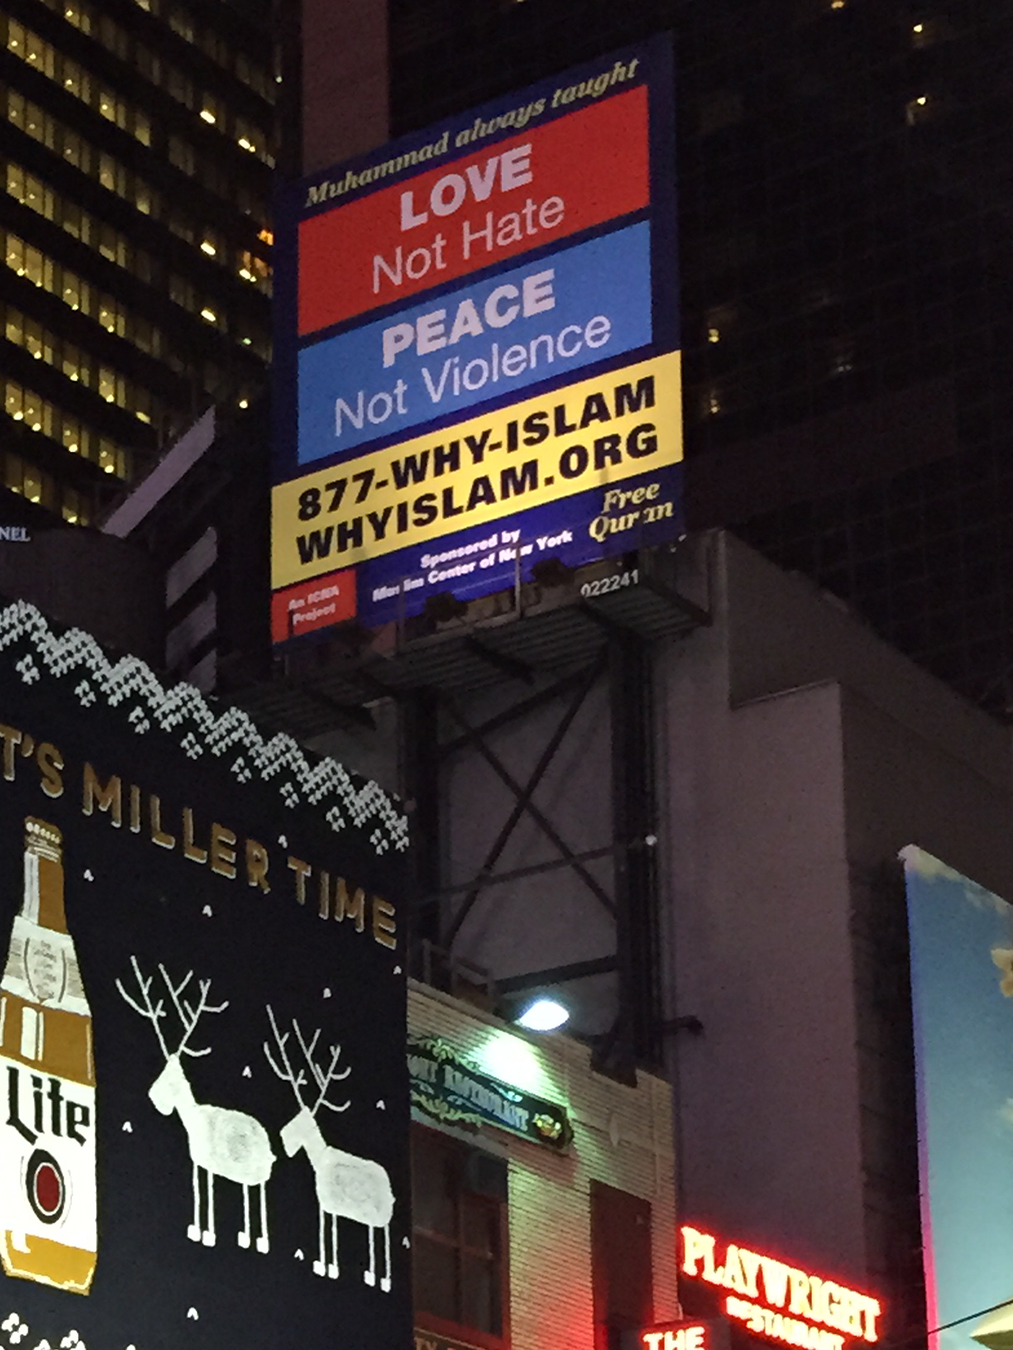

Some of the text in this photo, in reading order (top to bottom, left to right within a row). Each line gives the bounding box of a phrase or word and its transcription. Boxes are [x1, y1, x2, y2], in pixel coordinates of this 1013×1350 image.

[304, 58, 640, 208] Muhammad always taught
[400, 144, 533, 231] LOVE
[372, 195, 566, 294] Not Hate
[382, 269, 556, 369] PEACE
[334, 313, 612, 437] Not Violence
[296, 424, 659, 565] WHYISLAM.ORG
[297, 375, 656, 522] 877-WHY-ISLAM
[601, 482, 661, 514] Free
[420, 528, 521, 570] Sponsored by
[427, 562, 477, 585] Center
[479, 552, 496, 569] of
[536, 530, 573, 551] York
[580, 570, 640, 598] 022241
[292, 602, 336, 625] Project
[82, 762, 272, 894] MILLER
[287, 856, 397, 950] TIME
[5, 1066, 92, 1147] Lite
[680, 1226, 882, 1344] PLAYWRIGHT
